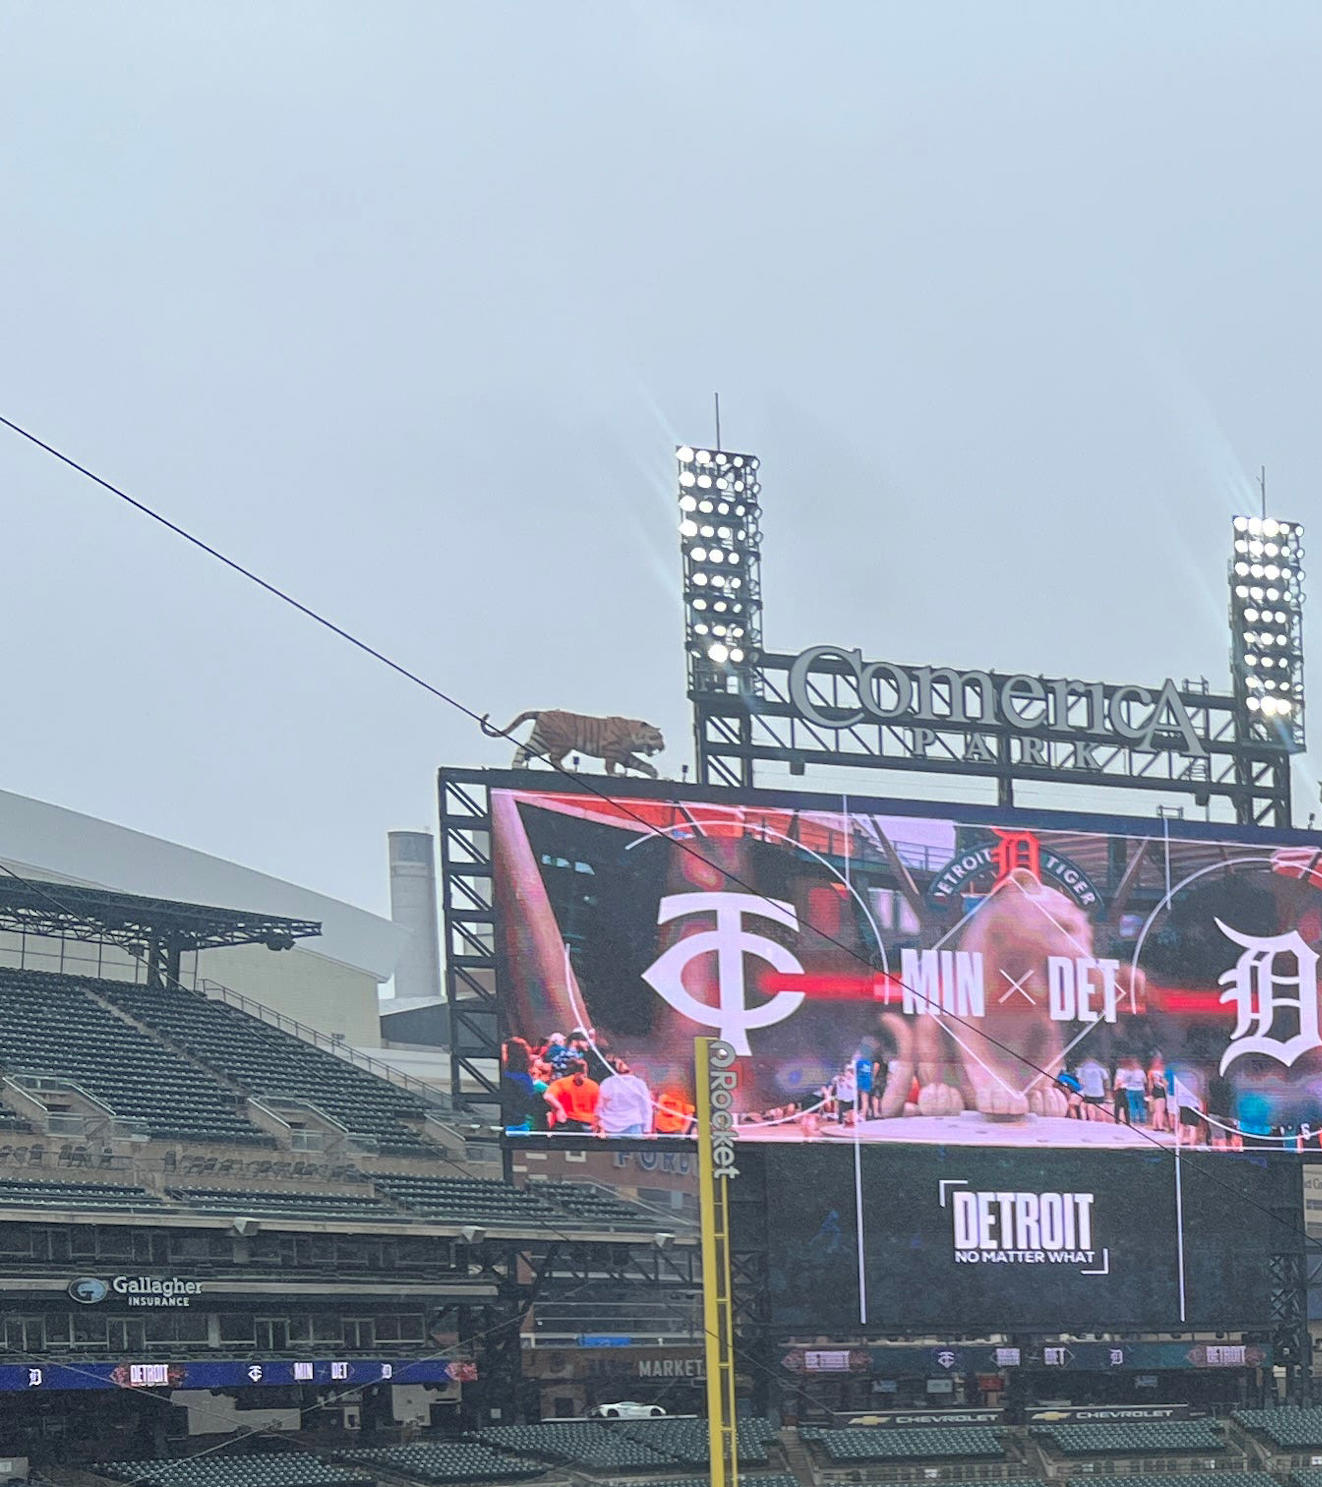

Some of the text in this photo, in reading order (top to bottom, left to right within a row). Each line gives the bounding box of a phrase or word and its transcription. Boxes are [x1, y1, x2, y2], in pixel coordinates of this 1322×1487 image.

[911, 728, 1100, 770] PARK
[902, 948, 1119, 1023] MIN DET
[710, 1069, 740, 1179] Rocket
[953, 1191, 1094, 1250] DETROIT
[955, 1251, 1095, 1263] NO MATTER WHAT
[113, 1276, 202, 1297] Gallagher
[128, 1297, 190, 1307] INSURANCE
[639, 1360, 703, 1377] MARKET
[895, 1414, 998, 1424] CHEVROLET
[1076, 1410, 1174, 1420] CHEVROLET
